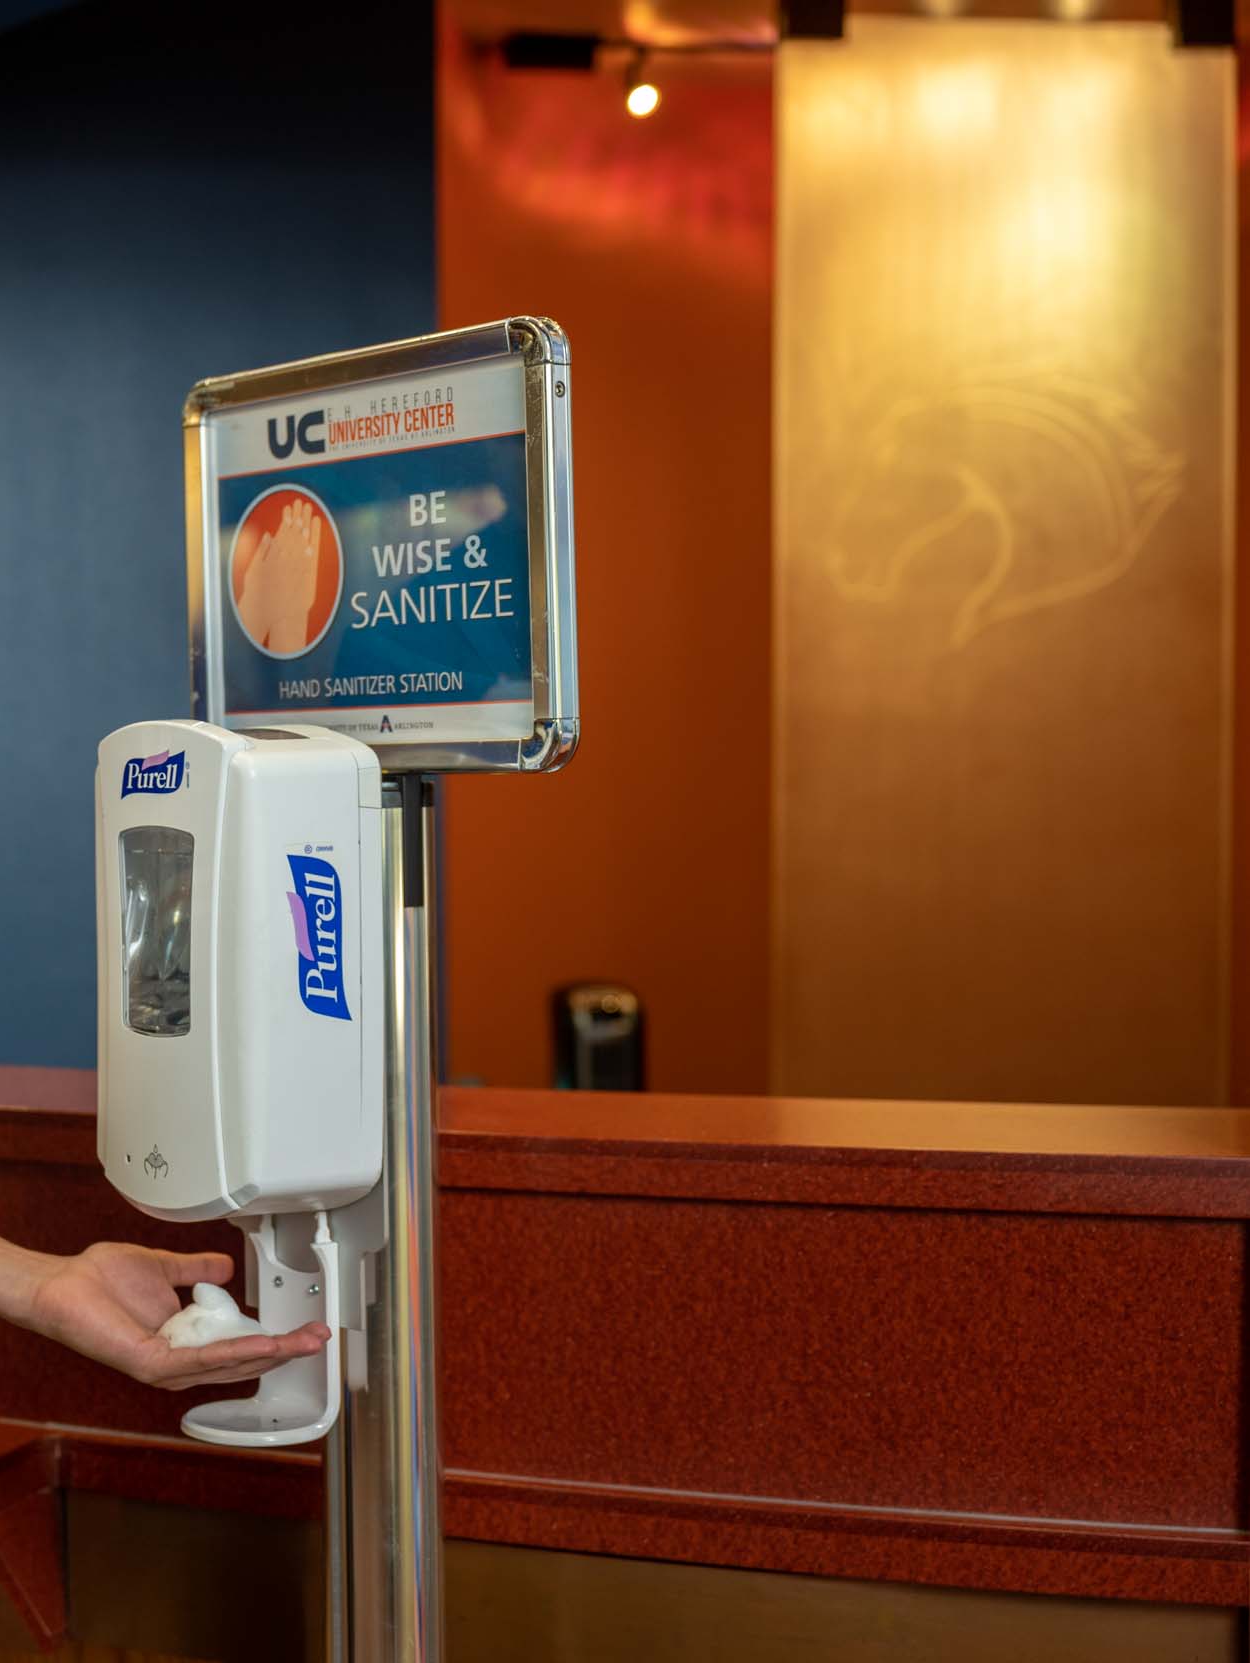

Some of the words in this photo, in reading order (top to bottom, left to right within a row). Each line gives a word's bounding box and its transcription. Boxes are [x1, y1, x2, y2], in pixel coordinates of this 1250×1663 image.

[370, 386, 454, 416] HEREFORD
[267, 408, 326, 460] UC
[328, 411, 401, 445] UNIVERSITY
[404, 402, 455, 432] CENTER
[409, 490, 447, 528] BE
[371, 537, 452, 578] WISE
[463, 534, 489, 569] &
[350, 578, 515, 630] SANITIZE
[279, 679, 320, 699] HAND
[324, 674, 396, 698] SANITIZER
[400, 671, 463, 694] STATION
[126, 763, 179, 790] Purell
[303, 872, 339, 1004] Purell
